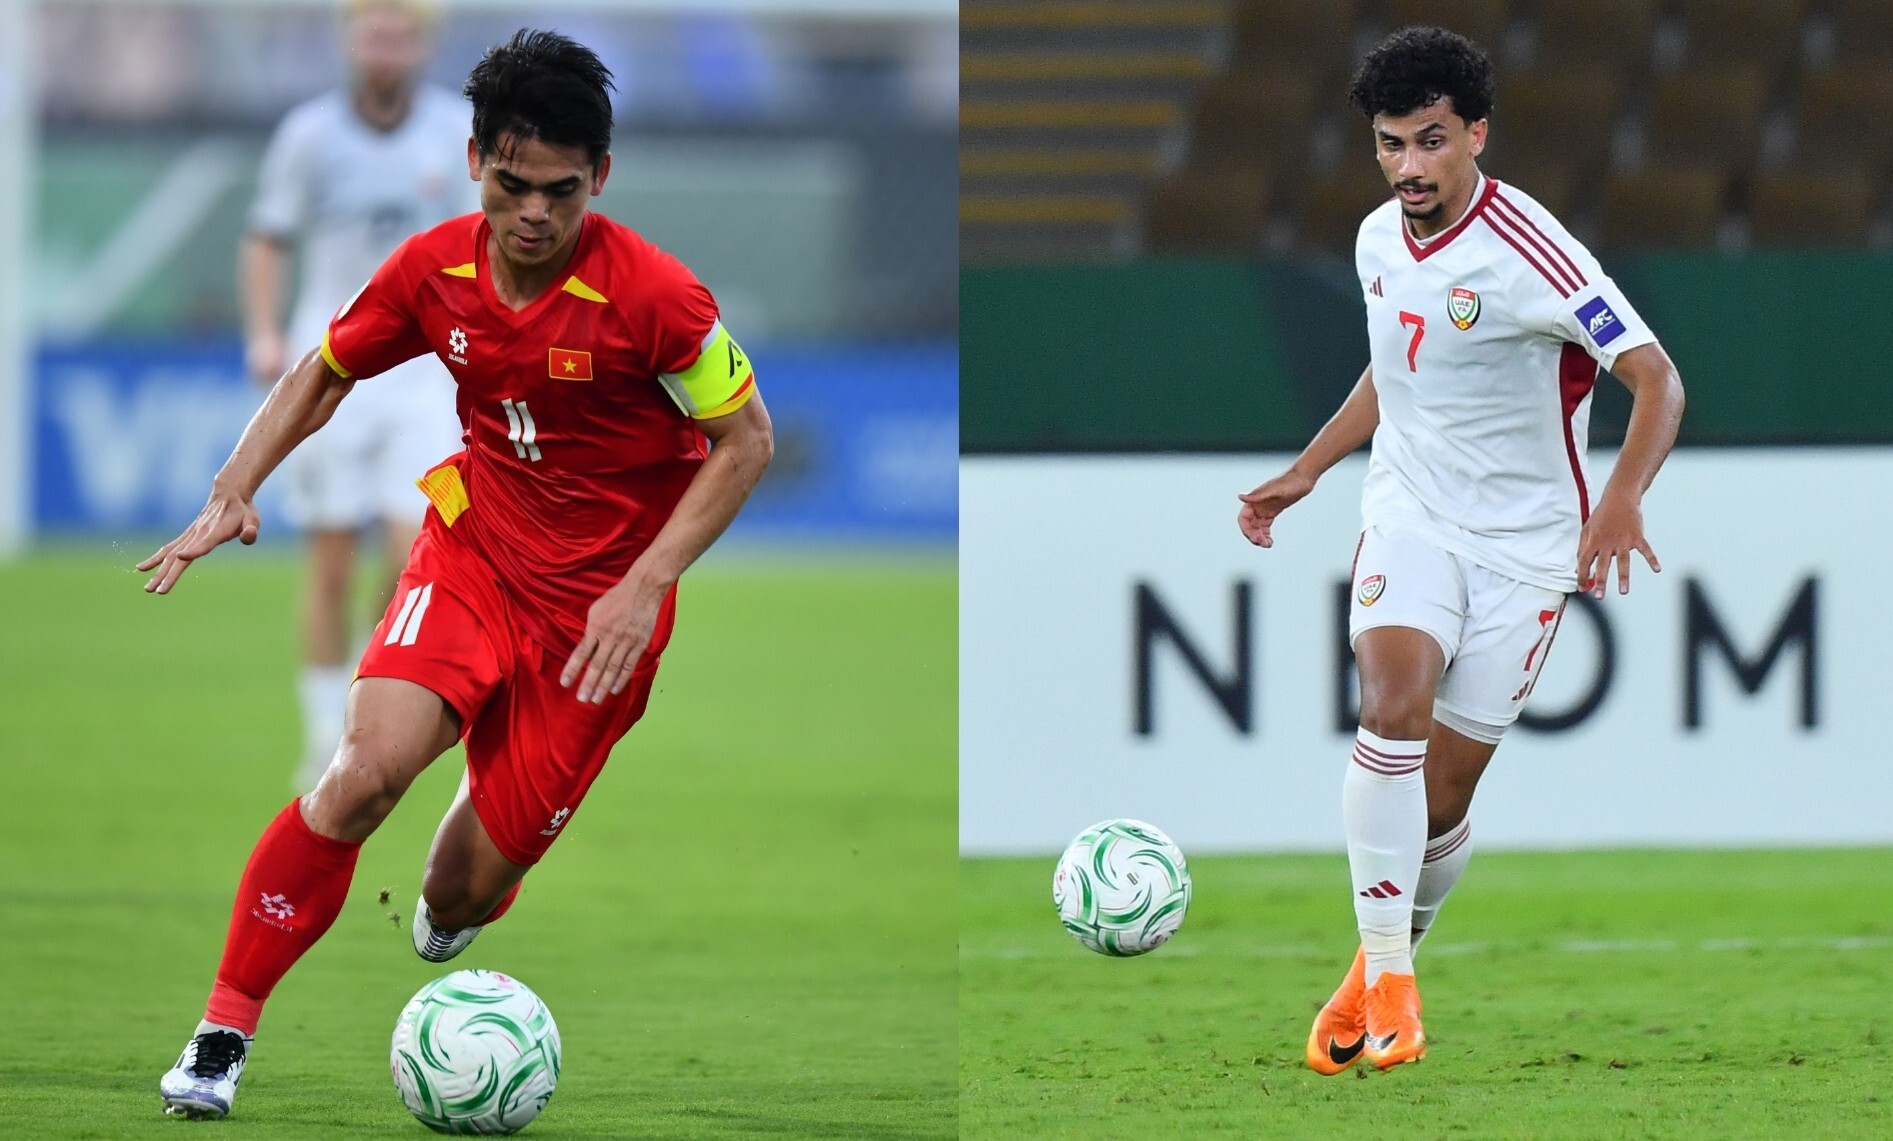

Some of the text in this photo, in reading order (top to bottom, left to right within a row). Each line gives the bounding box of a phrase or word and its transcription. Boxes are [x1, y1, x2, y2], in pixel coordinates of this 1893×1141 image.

[1454, 299, 1471, 308] UAE
[1589, 307, 1614, 333] AFC
[1399, 310, 1425, 373] 7
[501, 398, 542, 462] 11
[383, 581, 434, 647] 11
